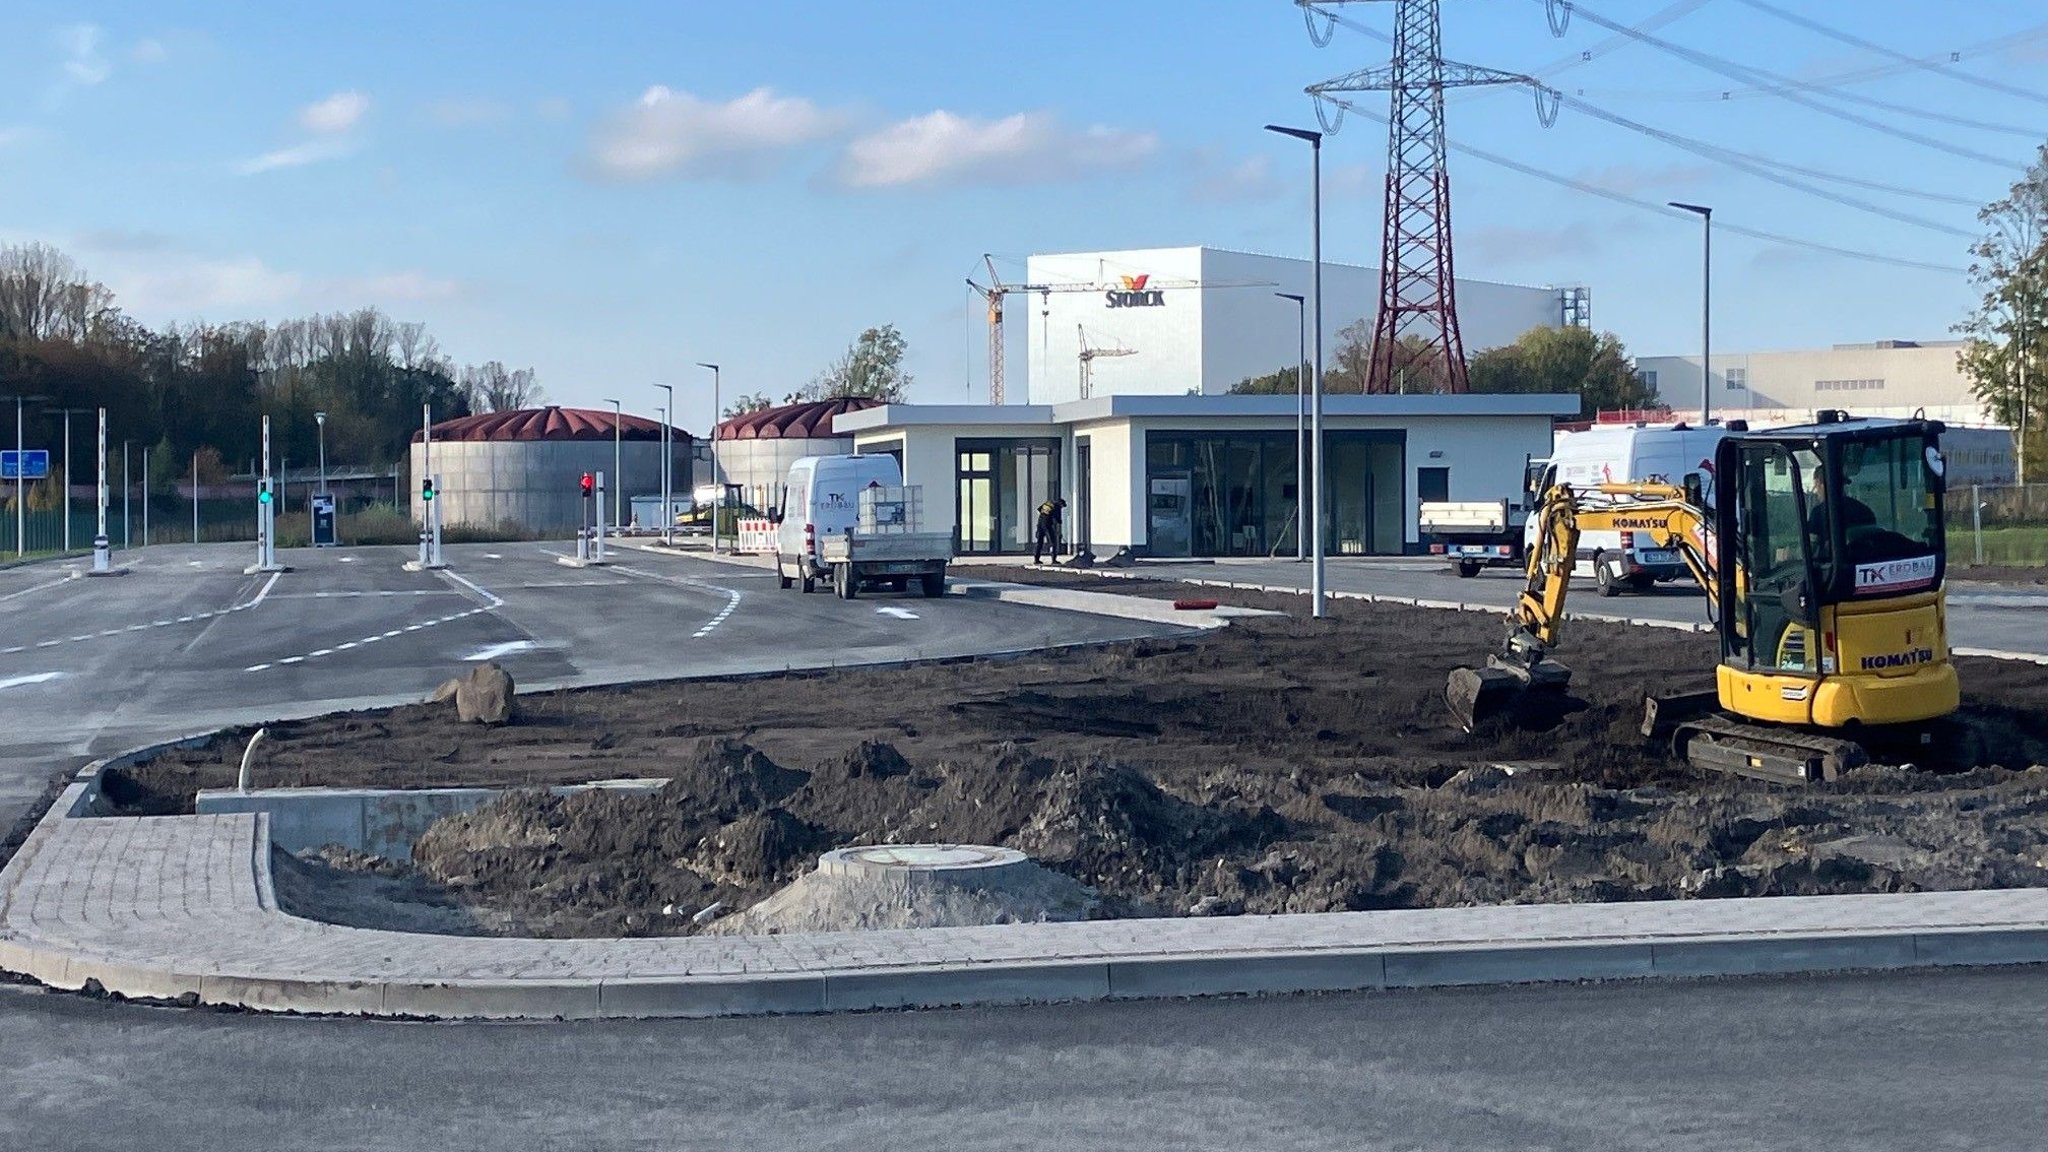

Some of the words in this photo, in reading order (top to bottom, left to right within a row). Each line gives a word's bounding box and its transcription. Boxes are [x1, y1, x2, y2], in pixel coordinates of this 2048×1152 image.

[1105, 290, 1165, 308] STORCK
[828, 493, 845, 503] TK
[1612, 517, 1667, 528] KOMATSU
[1859, 566, 1886, 583] TK
[1889, 558, 1933, 576] ERDBAU
[1861, 648, 1933, 669] KOMATSU
